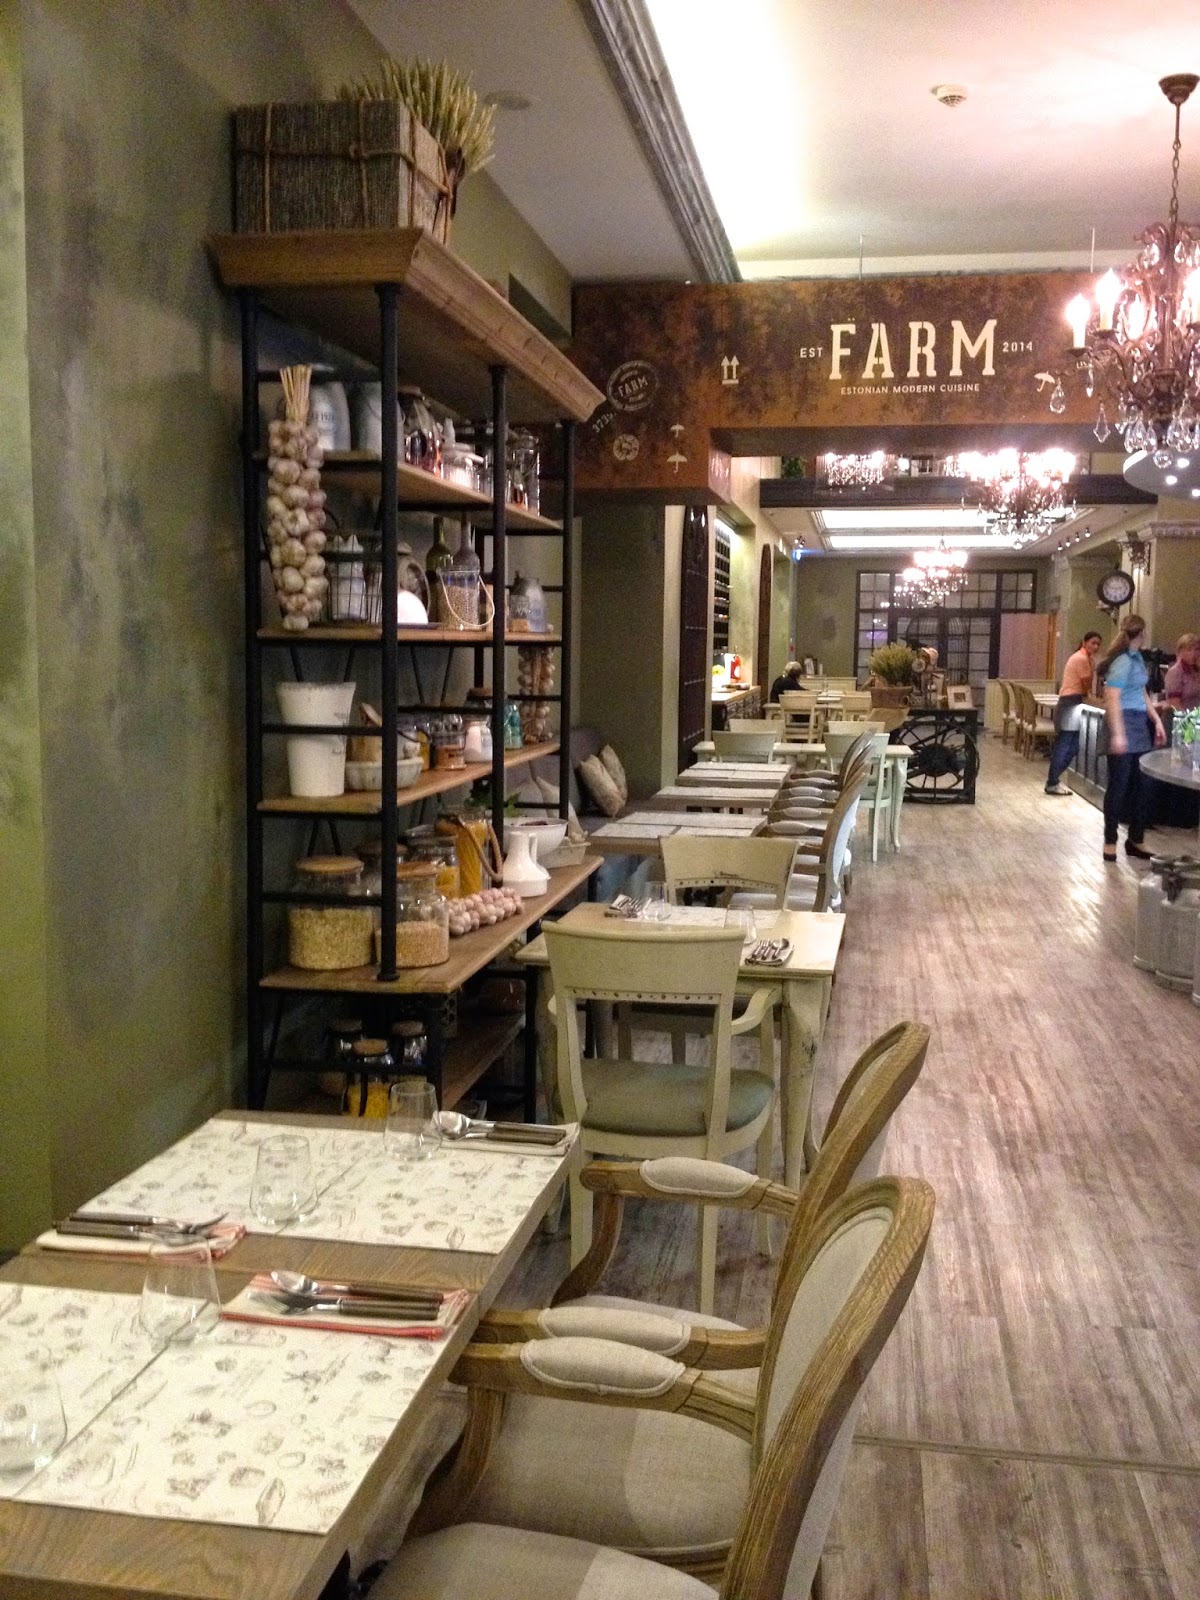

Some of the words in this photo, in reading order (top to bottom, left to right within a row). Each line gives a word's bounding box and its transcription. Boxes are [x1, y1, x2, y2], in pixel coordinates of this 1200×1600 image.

[800, 347, 823, 358] EST
[829, 319, 997, 380] FARM
[1002, 341, 1033, 353] 2014
[617, 375, 649, 398] FARM
[841, 386, 888, 395] ESTONIAN
[893, 384, 935, 393] MODERN
[940, 383, 980, 392] CUISINE
